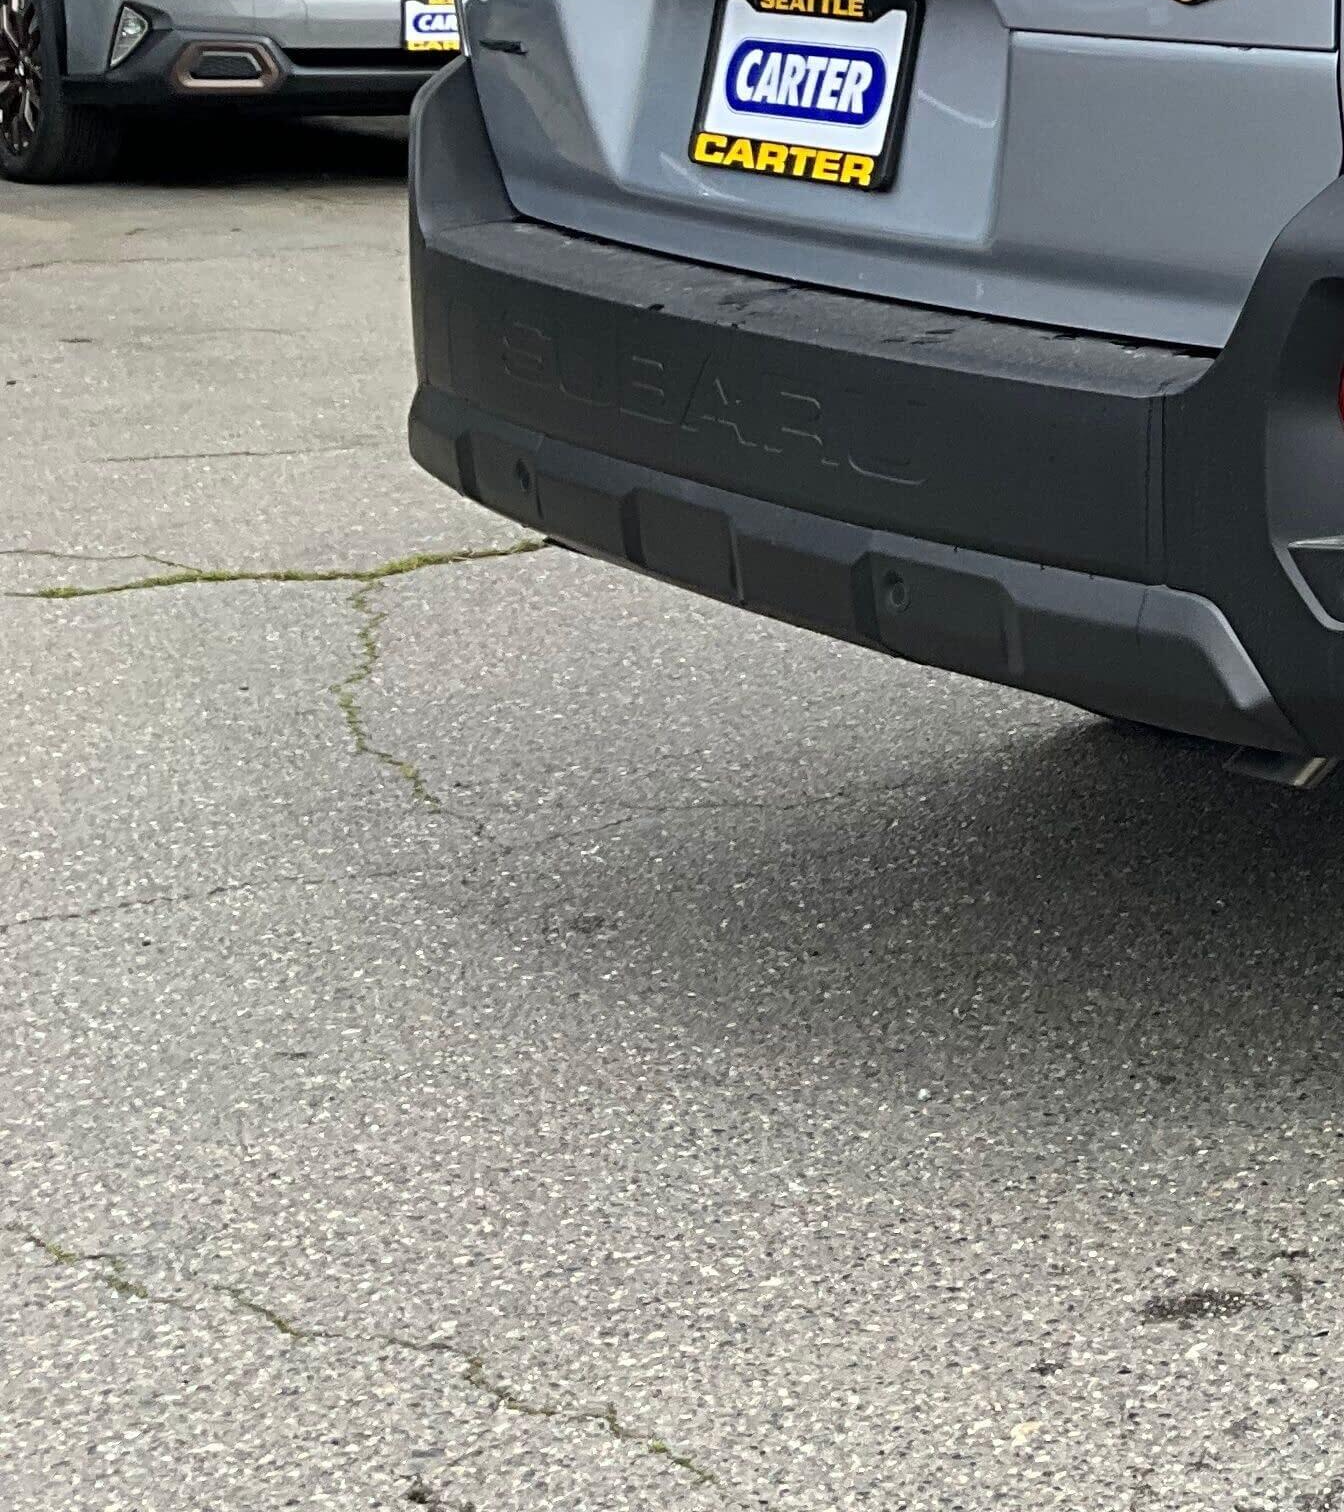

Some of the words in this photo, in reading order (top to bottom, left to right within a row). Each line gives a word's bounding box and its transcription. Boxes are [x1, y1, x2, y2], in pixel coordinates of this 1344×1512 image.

[735, 48, 873, 115] CARTER
[694, 132, 875, 187] CARTER
[502, 320, 927, 486] SUBARU
